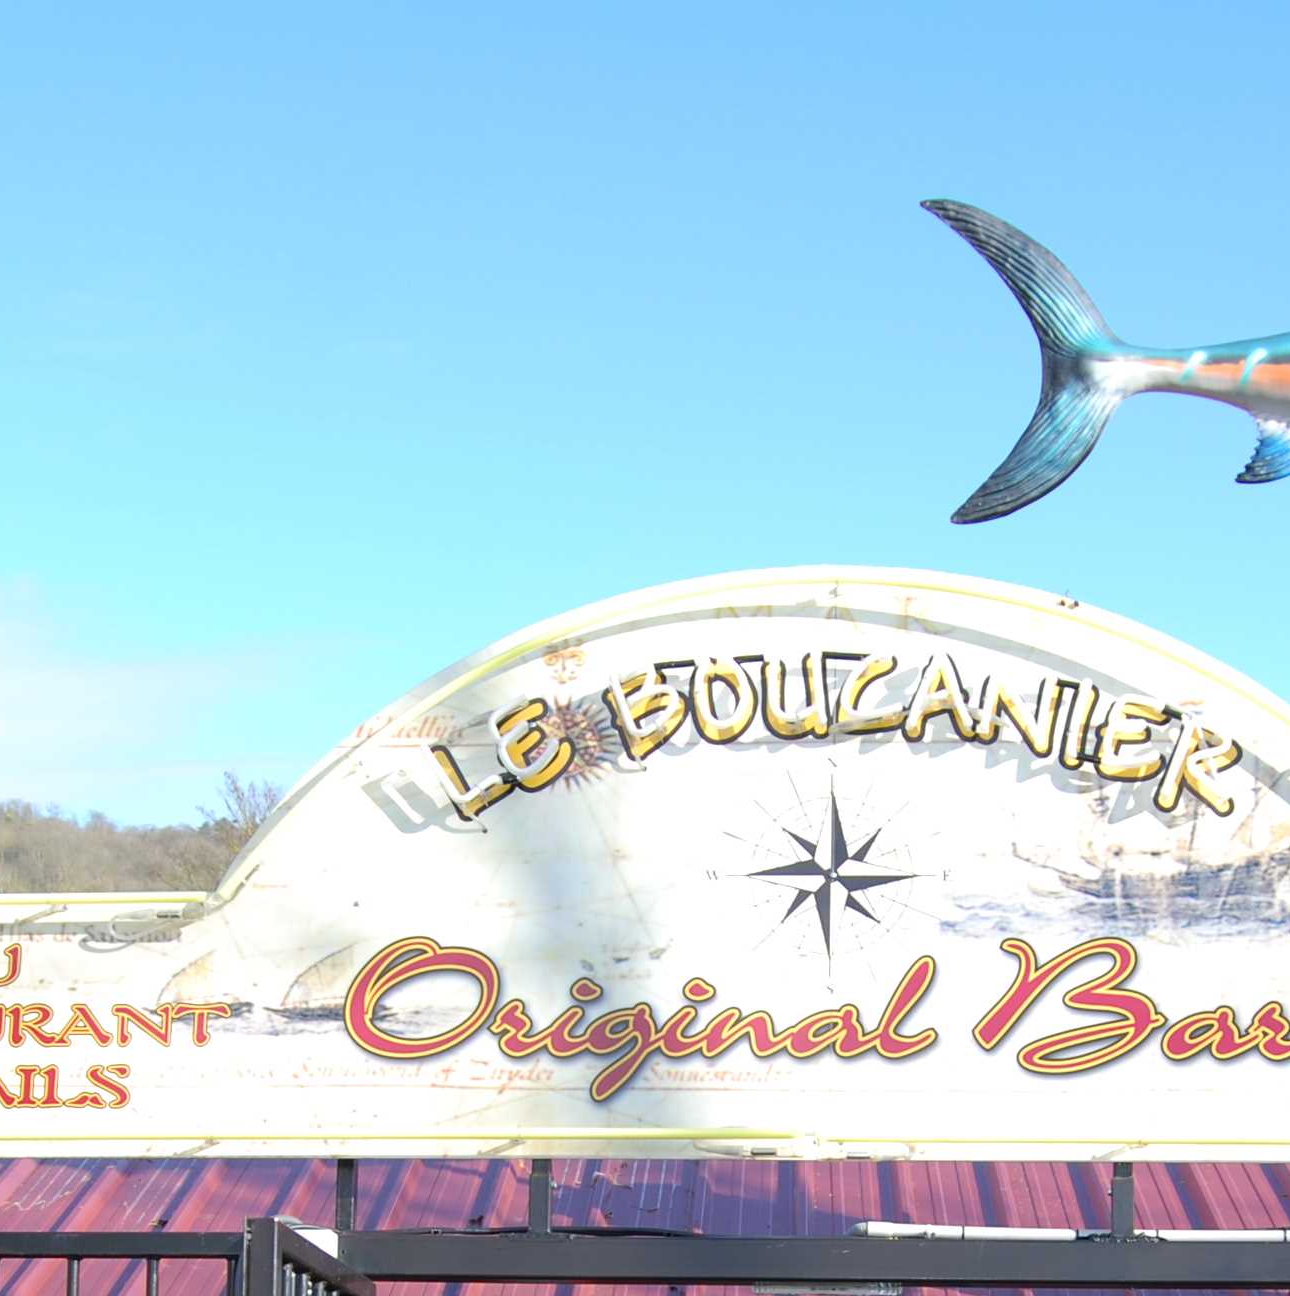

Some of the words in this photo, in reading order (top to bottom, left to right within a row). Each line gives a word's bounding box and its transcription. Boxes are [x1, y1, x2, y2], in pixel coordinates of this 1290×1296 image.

[423, 697, 576, 823] LE
[601, 652, 1243, 818] BOUCANIER
[345, 936, 938, 1102] Original
